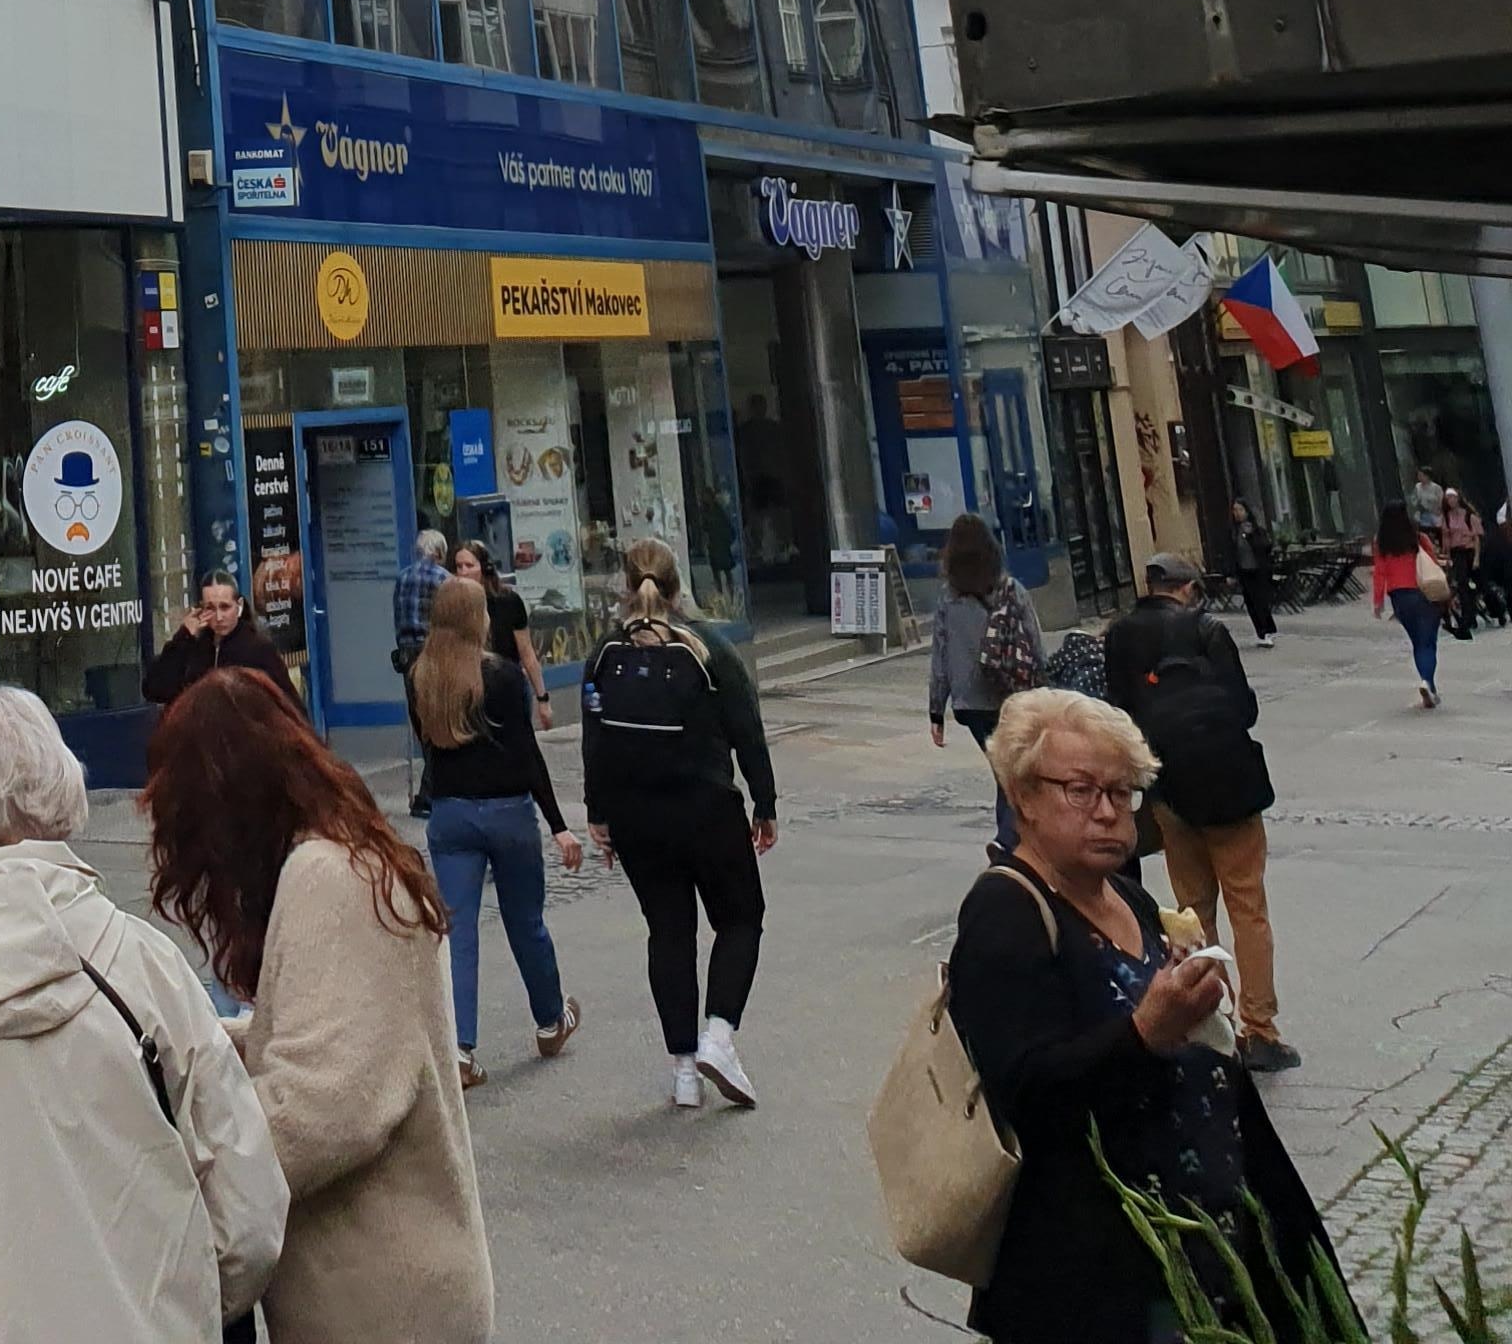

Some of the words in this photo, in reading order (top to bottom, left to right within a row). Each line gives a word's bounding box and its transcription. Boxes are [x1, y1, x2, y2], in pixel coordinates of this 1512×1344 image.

[235, 149, 284, 160] BANKOMAT
[498, 151, 525, 184] Váš
[528, 157, 575, 191] partner
[579, 163, 597, 191] od
[598, 164, 626, 194] roku
[628, 166, 653, 197] 1907
[501, 278, 584, 315] PEKAŘSTVÍ
[585, 287, 642, 316] Makovec
[30, 443, 53, 474] PAN
[56, 429, 117, 474] CROISSANT
[256, 452, 285, 473] Denně
[254, 477, 289, 496] čerstvé
[31, 561, 80, 593] NOVÉ
[83, 558, 122, 591] CAFÉ
[1, 601, 72, 634] NEJVÝŠ
[75, 606, 87, 629] V
[90, 600, 143, 629] CENTRU
